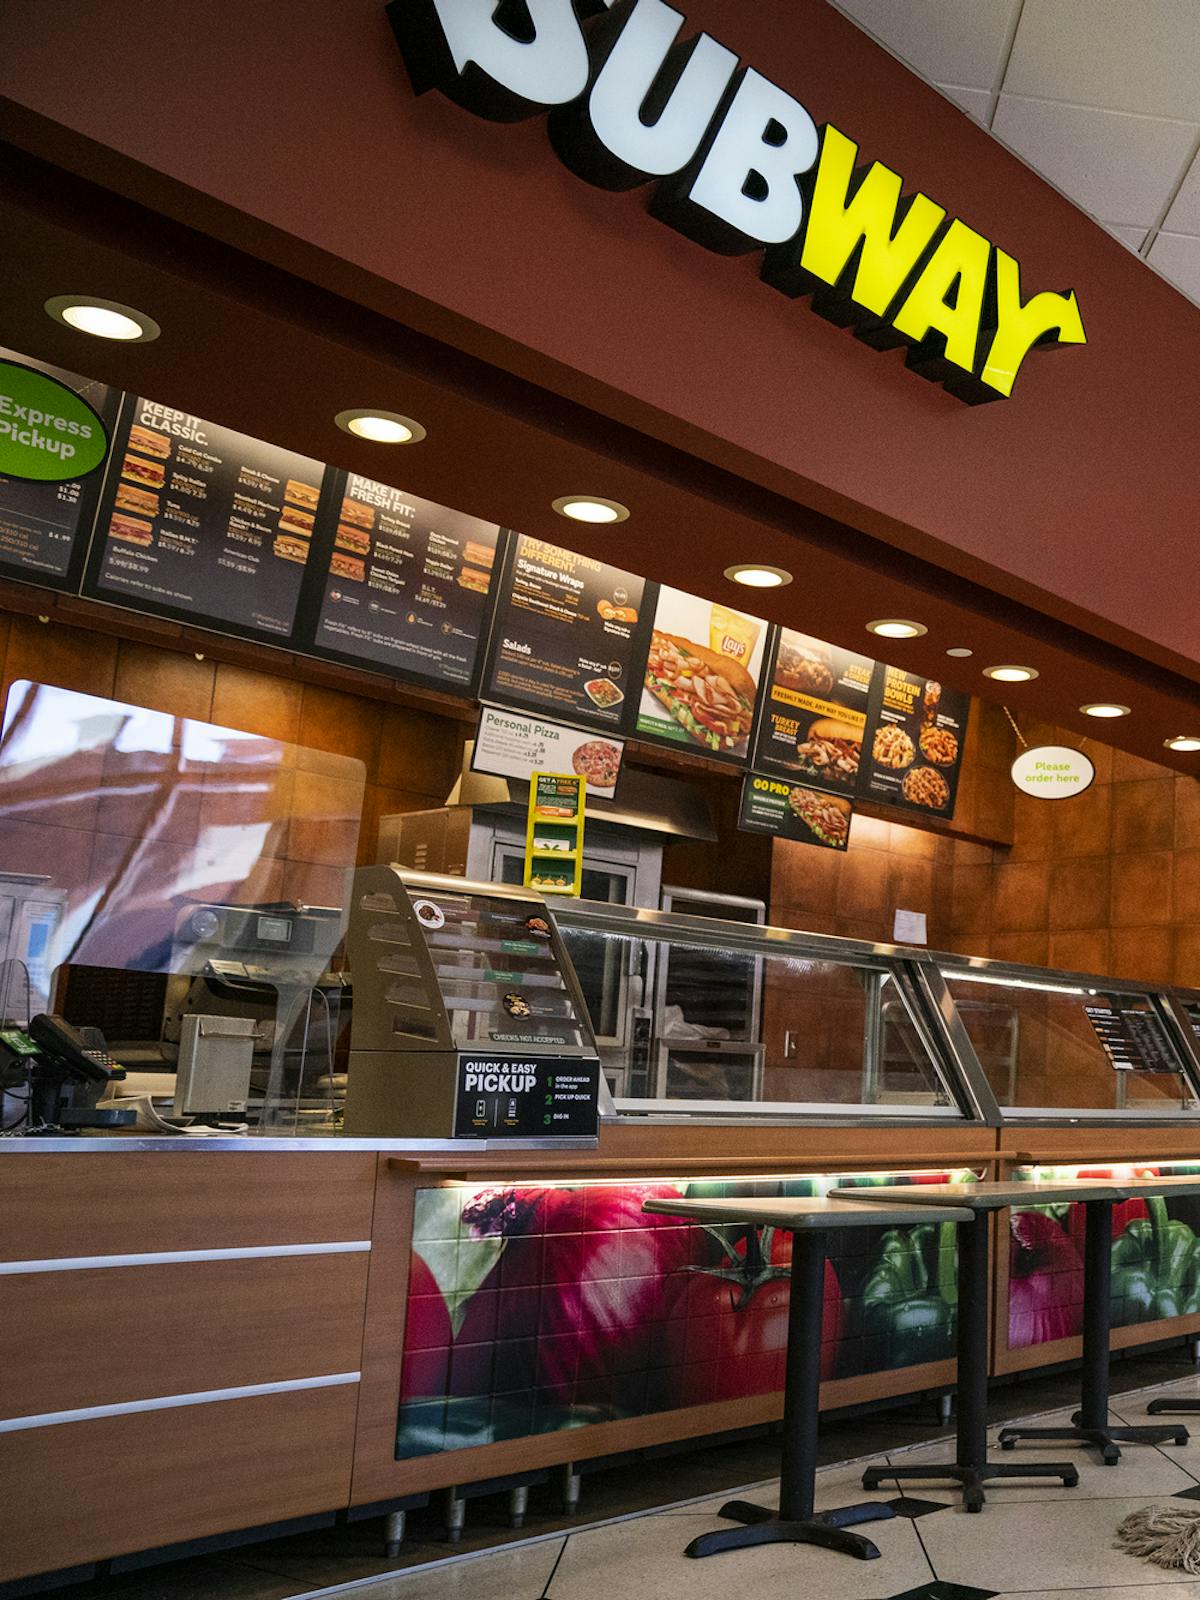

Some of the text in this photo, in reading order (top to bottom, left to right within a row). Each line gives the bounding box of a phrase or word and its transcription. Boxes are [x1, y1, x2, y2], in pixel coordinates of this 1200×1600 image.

[0, 395, 92, 439] Express
[143, 400, 202, 429] KEEP IT
[140, 412, 208, 446] CLASSIC.
[0, 420, 76, 460] Pickup
[352, 475, 402, 502] MAKE IT
[350, 487, 391, 511] FRESH
[520, 546, 576, 574] DIFFERENT.
[523, 538, 601, 573] TRY SOMETHING
[517, 559, 558, 580] Signature
[559, 572, 585, 589] Wraps
[502, 638, 532, 655] Salads
[723, 636, 745, 656] Lay's
[886, 667, 908, 680] NEW
[884, 687, 914, 705] BOWLS
[886, 678, 922, 697] PROTEIN
[774, 690, 797, 702] FRESHLY
[815, 702, 825, 712] ANY
[838, 710, 847, 719] YOU
[486, 713, 560, 741] Personal Pizza
[771, 714, 800, 730] TURKEY
[774, 723, 798, 736] BREAST
[1035, 762, 1071, 771] Please
[752, 778, 790, 796] GO PRO
[1025, 774, 1080, 783] order here
[493, 1033, 566, 1045] CHECKS NOT ACCEPTED
[465, 1061, 537, 1074] QUICK & EASY
[464, 1073, 537, 1093] PICKUP
[547, 1076, 553, 1087] 1
[544, 1094, 553, 1105] 2
[543, 1114, 552, 1125] 3
